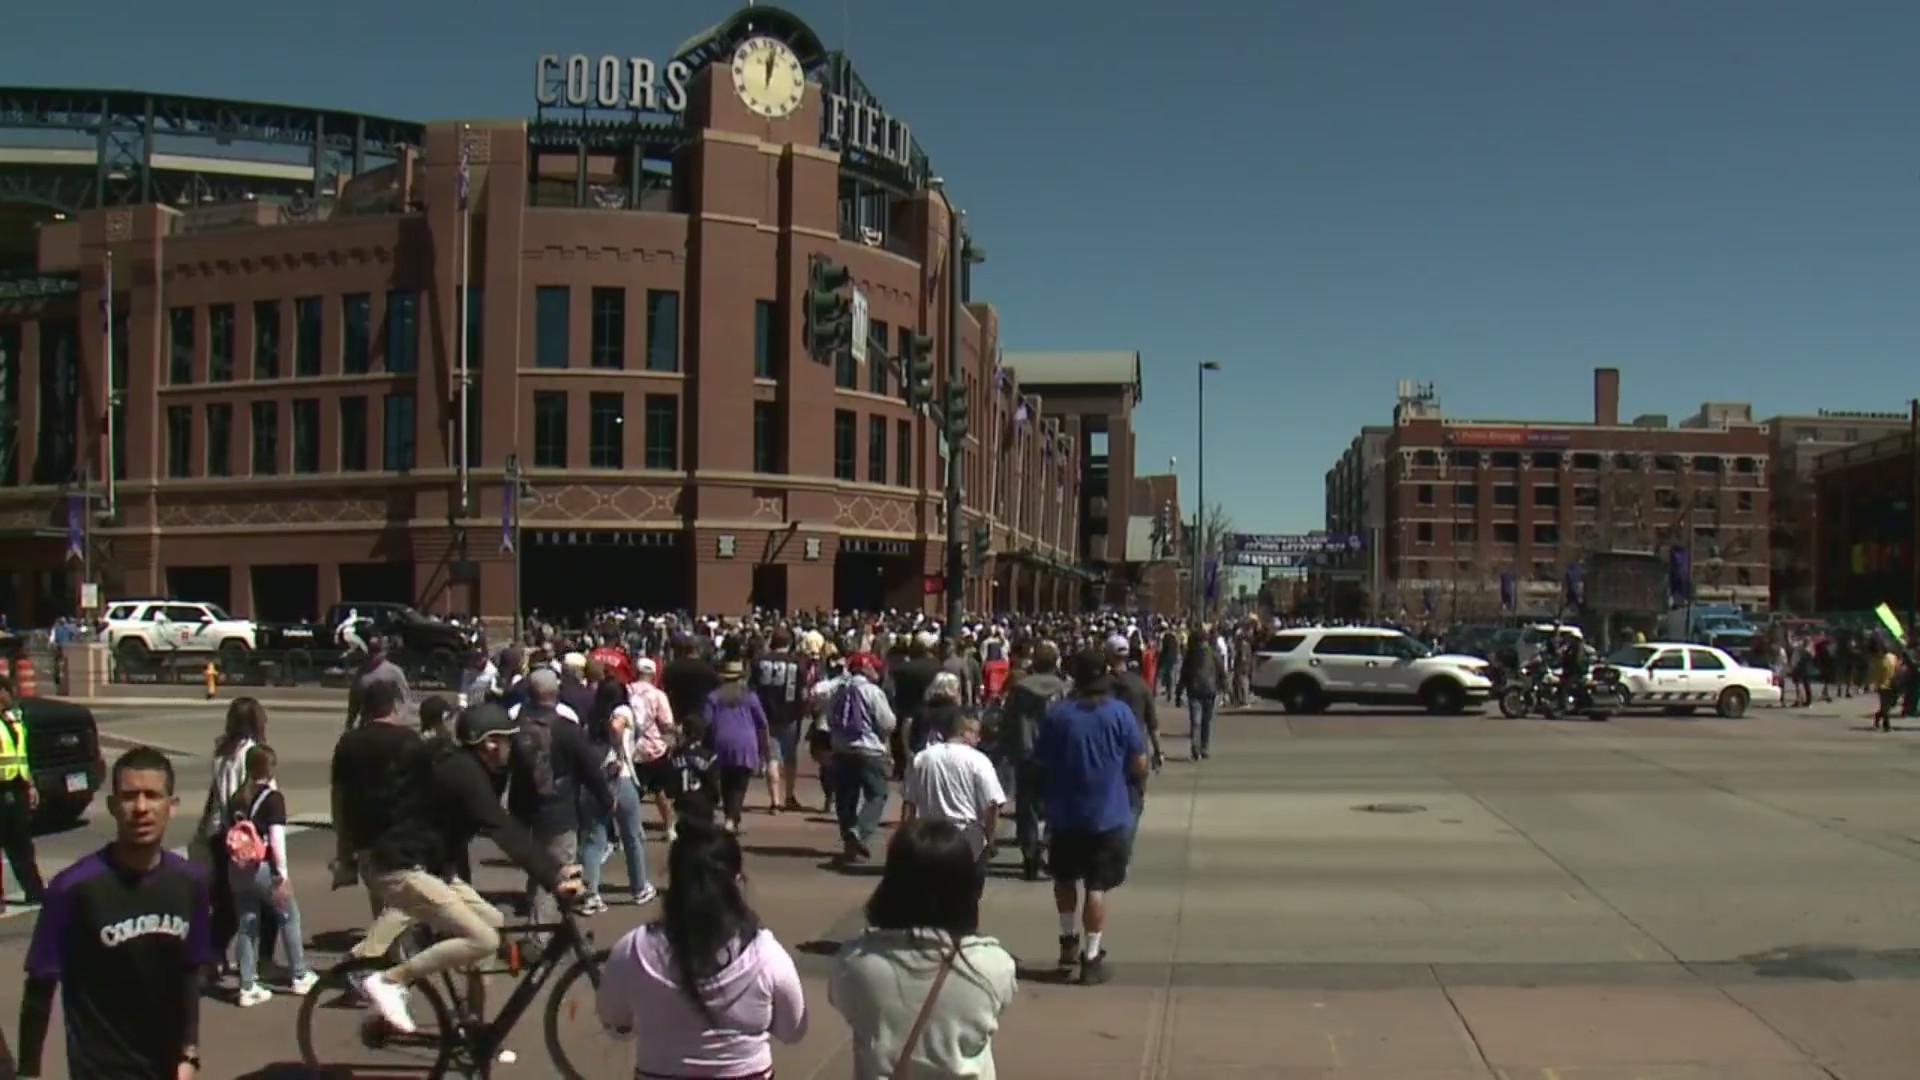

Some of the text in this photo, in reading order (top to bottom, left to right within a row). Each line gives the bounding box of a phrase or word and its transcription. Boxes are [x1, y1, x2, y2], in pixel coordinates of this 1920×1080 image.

[536, 53, 911, 168] COORS FIELD
[535, 530, 673, 546] HOME PLATE
[100, 912, 190, 947] COLORADO
